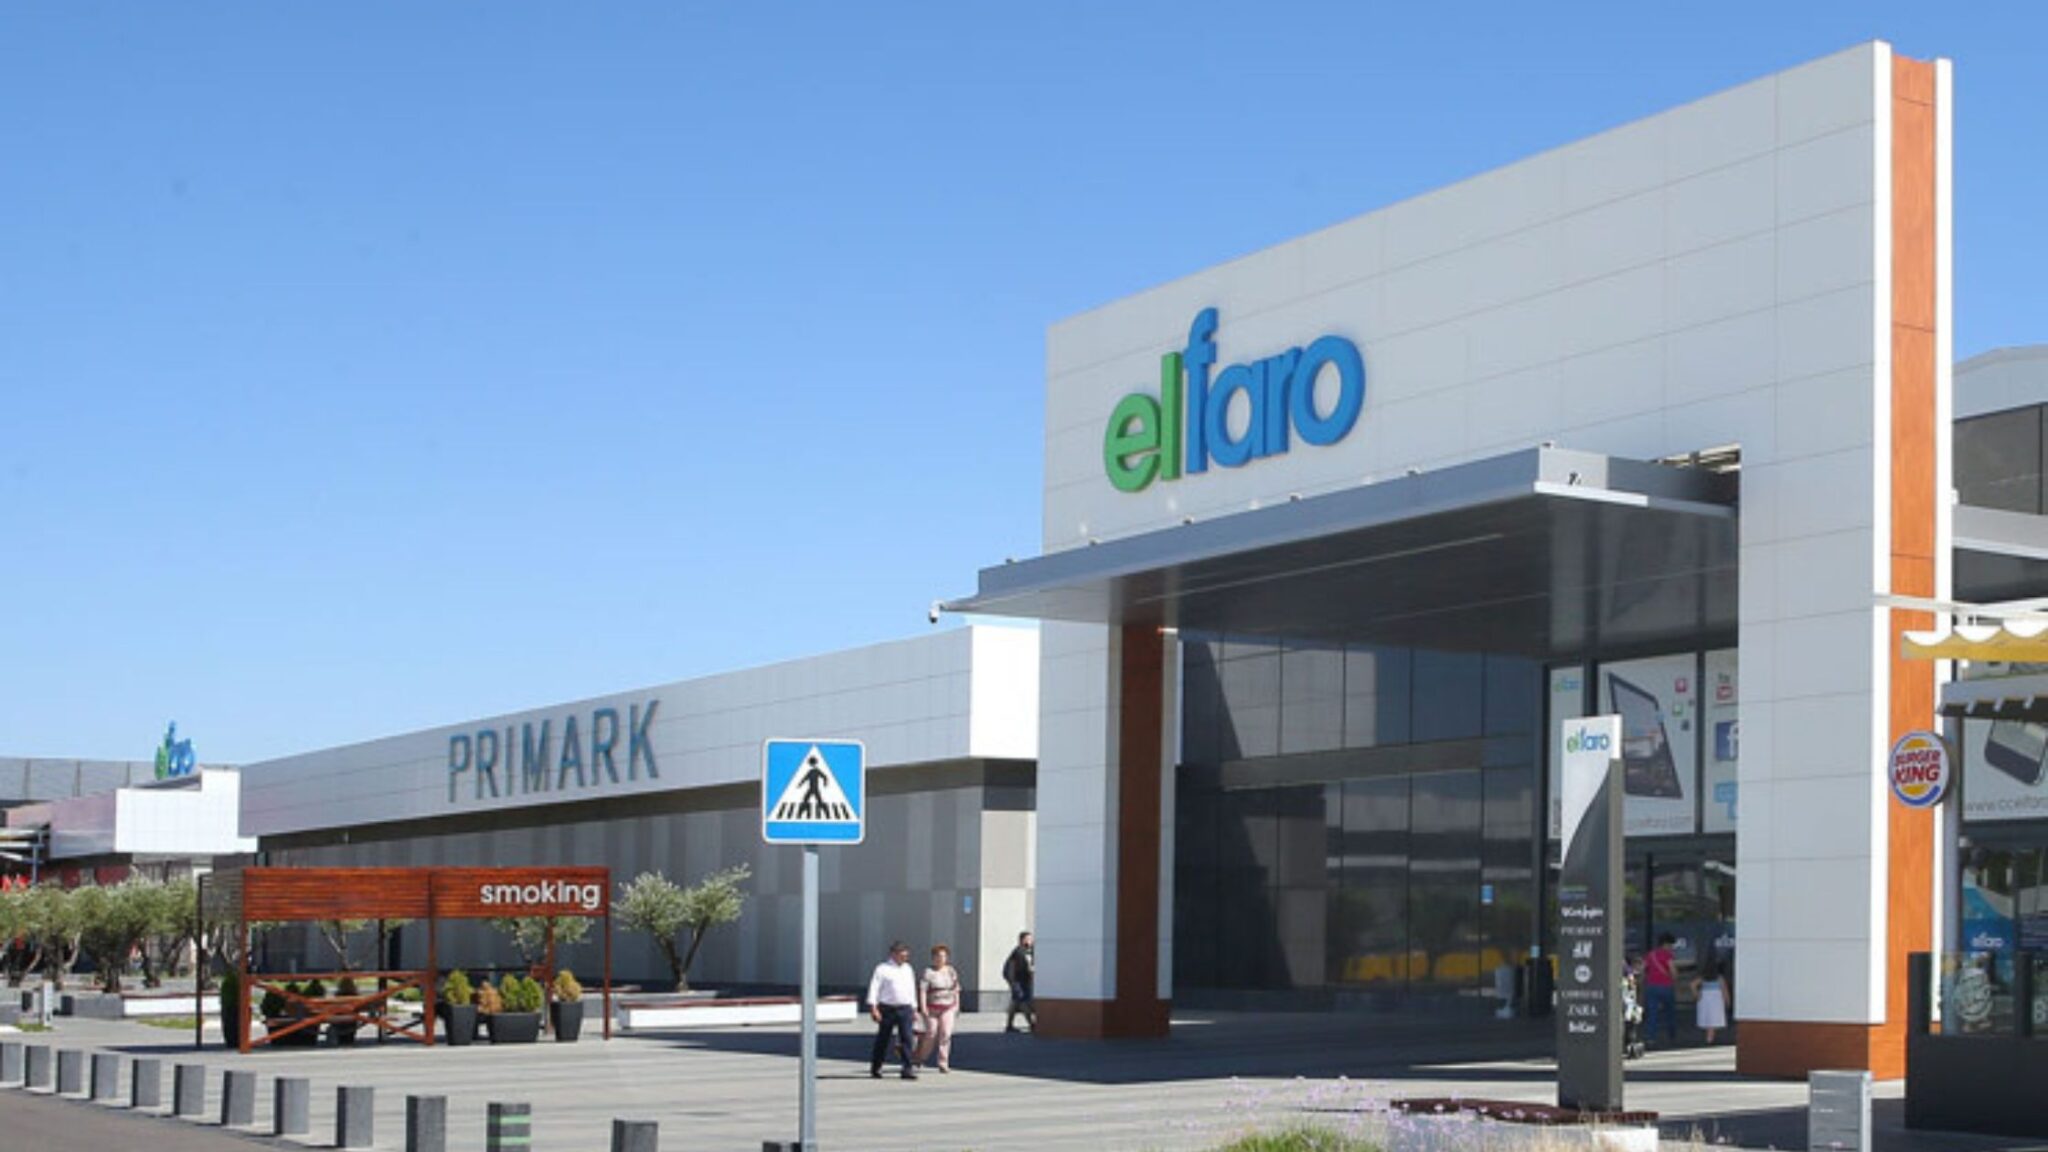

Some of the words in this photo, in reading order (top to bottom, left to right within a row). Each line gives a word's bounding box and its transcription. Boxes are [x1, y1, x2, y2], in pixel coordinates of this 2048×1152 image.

[448, 700, 660, 803] PRIMARK
[1895, 749, 1941, 765] BURGER
[1895, 764, 1941, 785] KING
[480, 879, 600, 910] smoking
